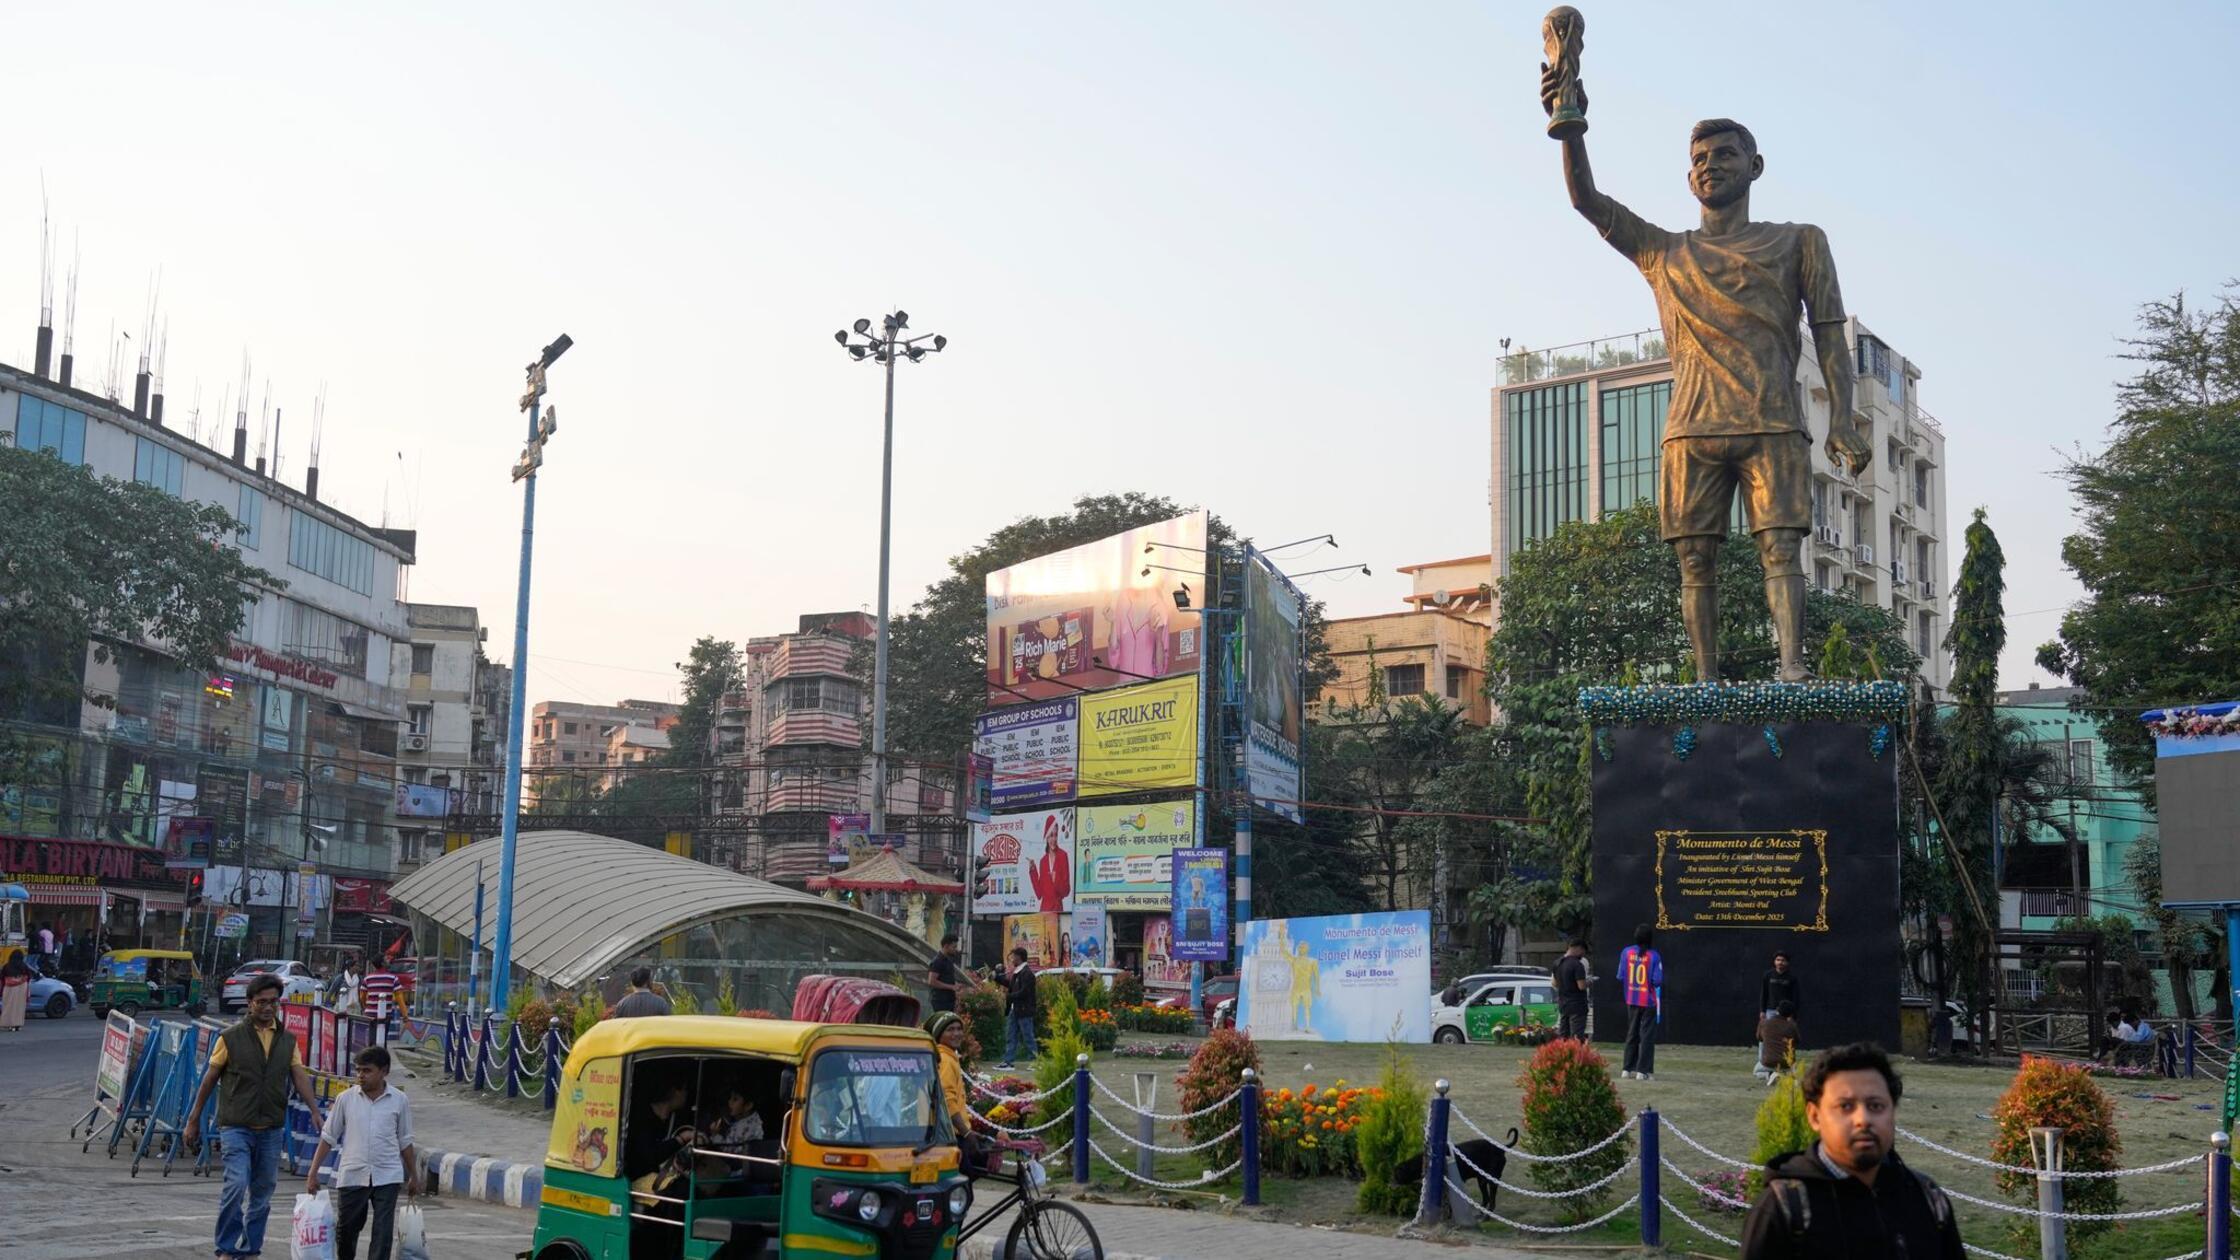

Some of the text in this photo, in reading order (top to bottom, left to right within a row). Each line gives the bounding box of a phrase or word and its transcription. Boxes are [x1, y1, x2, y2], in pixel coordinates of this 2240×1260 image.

[1025, 636, 1067, 657] Rich Marie
[987, 718, 997, 728] IEM
[998, 713, 1019, 726] GROUP
[1020, 711, 1030, 721] OF
[1030, 704, 1062, 720] SCHOOLS
[1096, 700, 1176, 729] KARUKRIT
[1024, 750, 1045, 759] SCHOOL
[1049, 745, 1071, 756] SCHOOL
[1676, 837, 1801, 849] Monumento de Messi
[46, 841, 134, 879] BIRYANI
[1678, 853, 1801, 862] Inaugurated by Lionel Messi himself
[1685, 865, 1697, 873] An
[1698, 865, 1729, 873] initiative
[1730, 865, 1739, 874] of
[1757, 865, 1773, 874] Sujit
[1774, 865, 1791, 873] Bose
[17, 873, 64, 884] RESTAURANT
[1677, 877, 1804, 886] Minister Government of West Bengal
[1681, 889, 1713, 897] President
[1750, 889, 1779, 898] Sporting
[1780, 889, 1797, 897] Club
[1695, 913, 1784, 921] Date: 13th December 2025
[1325, 924, 1417, 939] Monumento de Messi
[1318, 946, 1422, 961] Lionel Messi himself
[1345, 968, 1394, 978] Sujit Bose
[1629, 962, 1646, 985] 10
